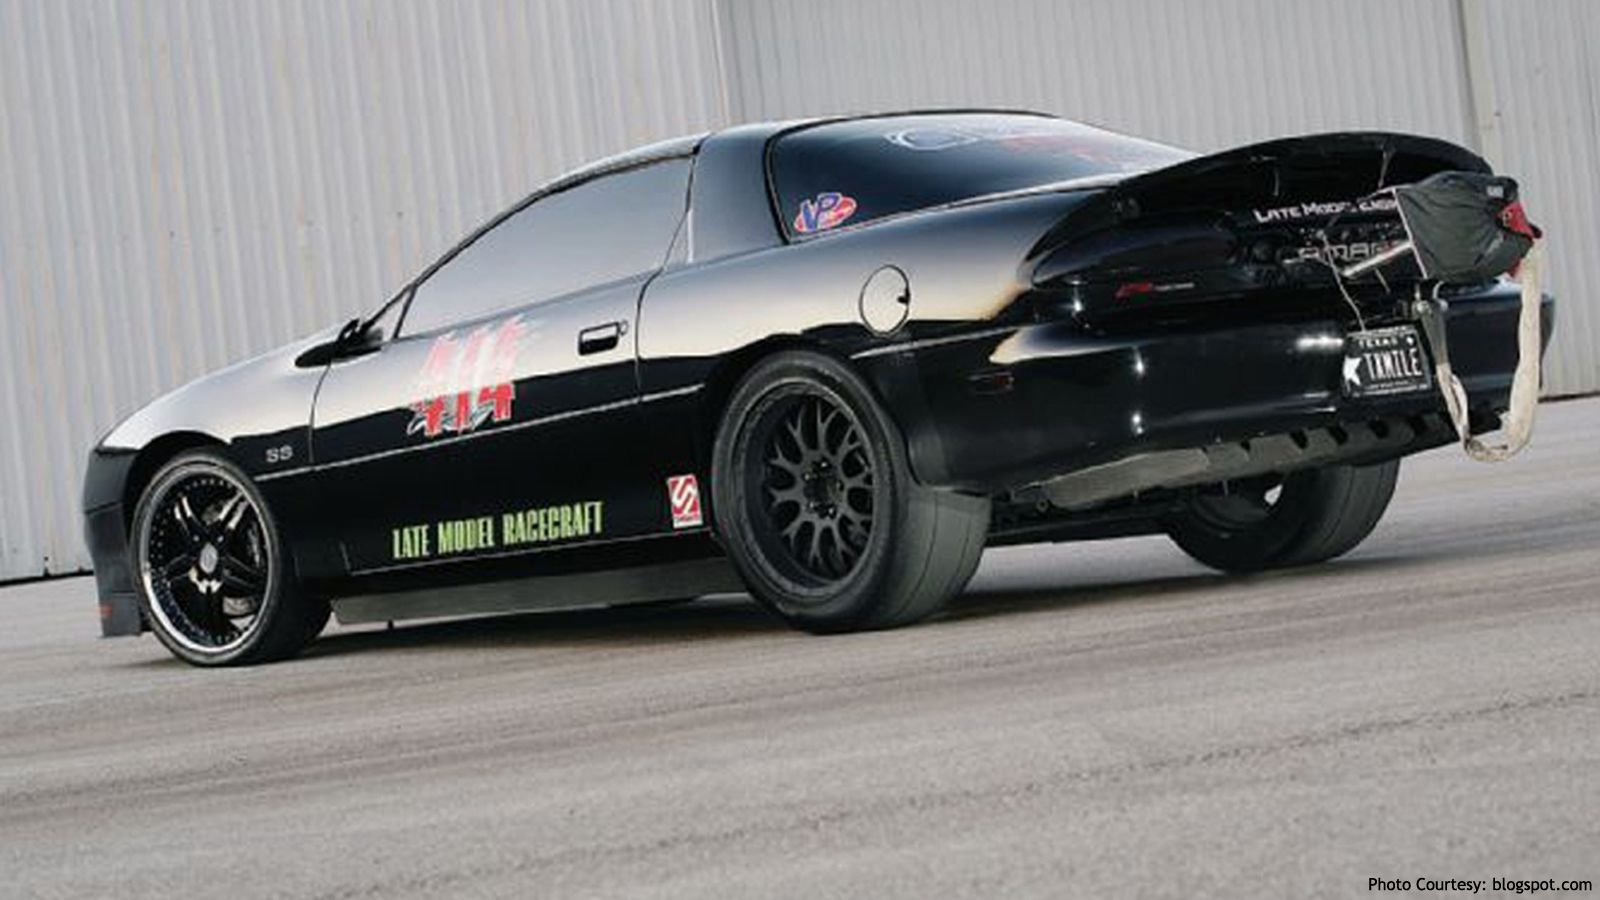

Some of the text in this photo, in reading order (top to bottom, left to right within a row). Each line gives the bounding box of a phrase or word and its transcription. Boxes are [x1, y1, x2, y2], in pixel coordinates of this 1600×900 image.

[1253, 206, 1301, 223] LATE
[265, 444, 293, 463] SS
[392, 501, 604, 559] LATE MODEL RACECRAFT
